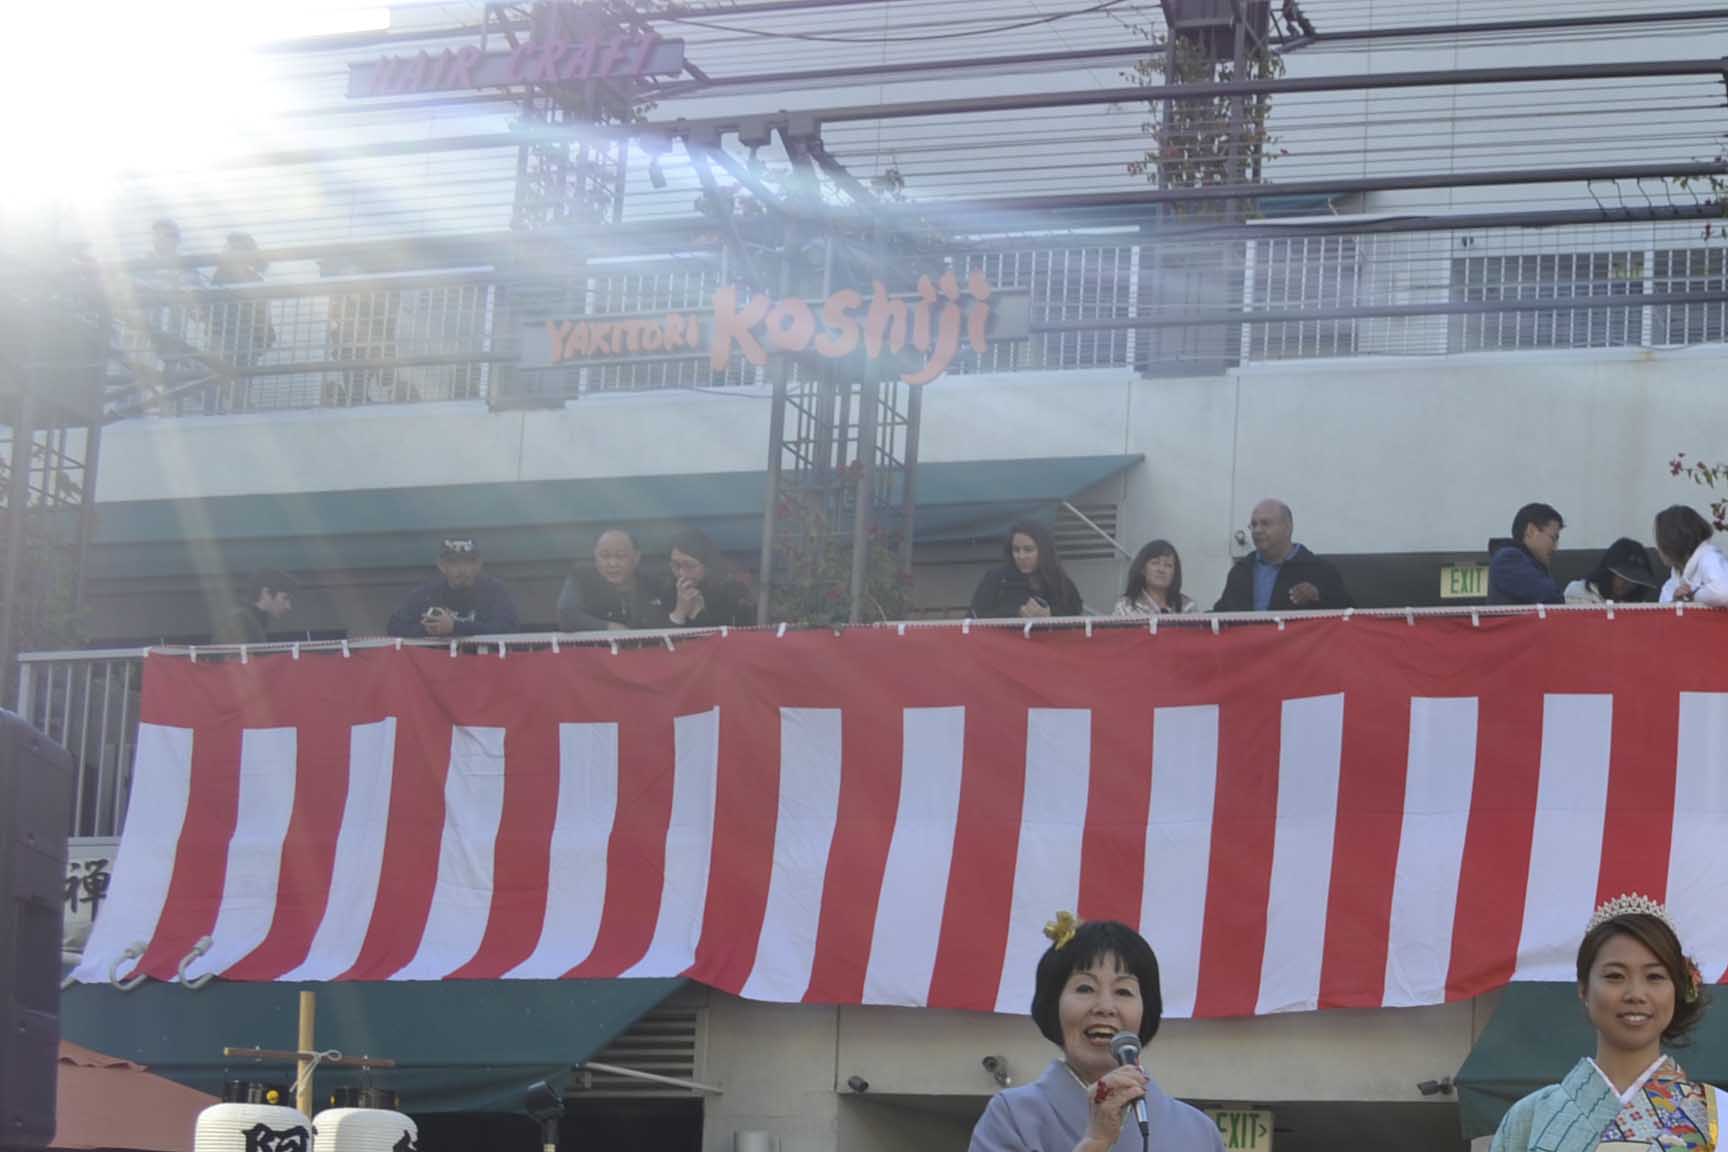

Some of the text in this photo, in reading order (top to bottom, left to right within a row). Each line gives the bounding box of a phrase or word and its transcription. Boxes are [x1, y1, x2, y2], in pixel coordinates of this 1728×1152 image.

[511, 32, 662, 80] CRAFT
[545, 314, 698, 363] YAKITORI
[1451, 567, 1481, 593] EXIT
[1216, 1111, 1260, 1149] EXIT
